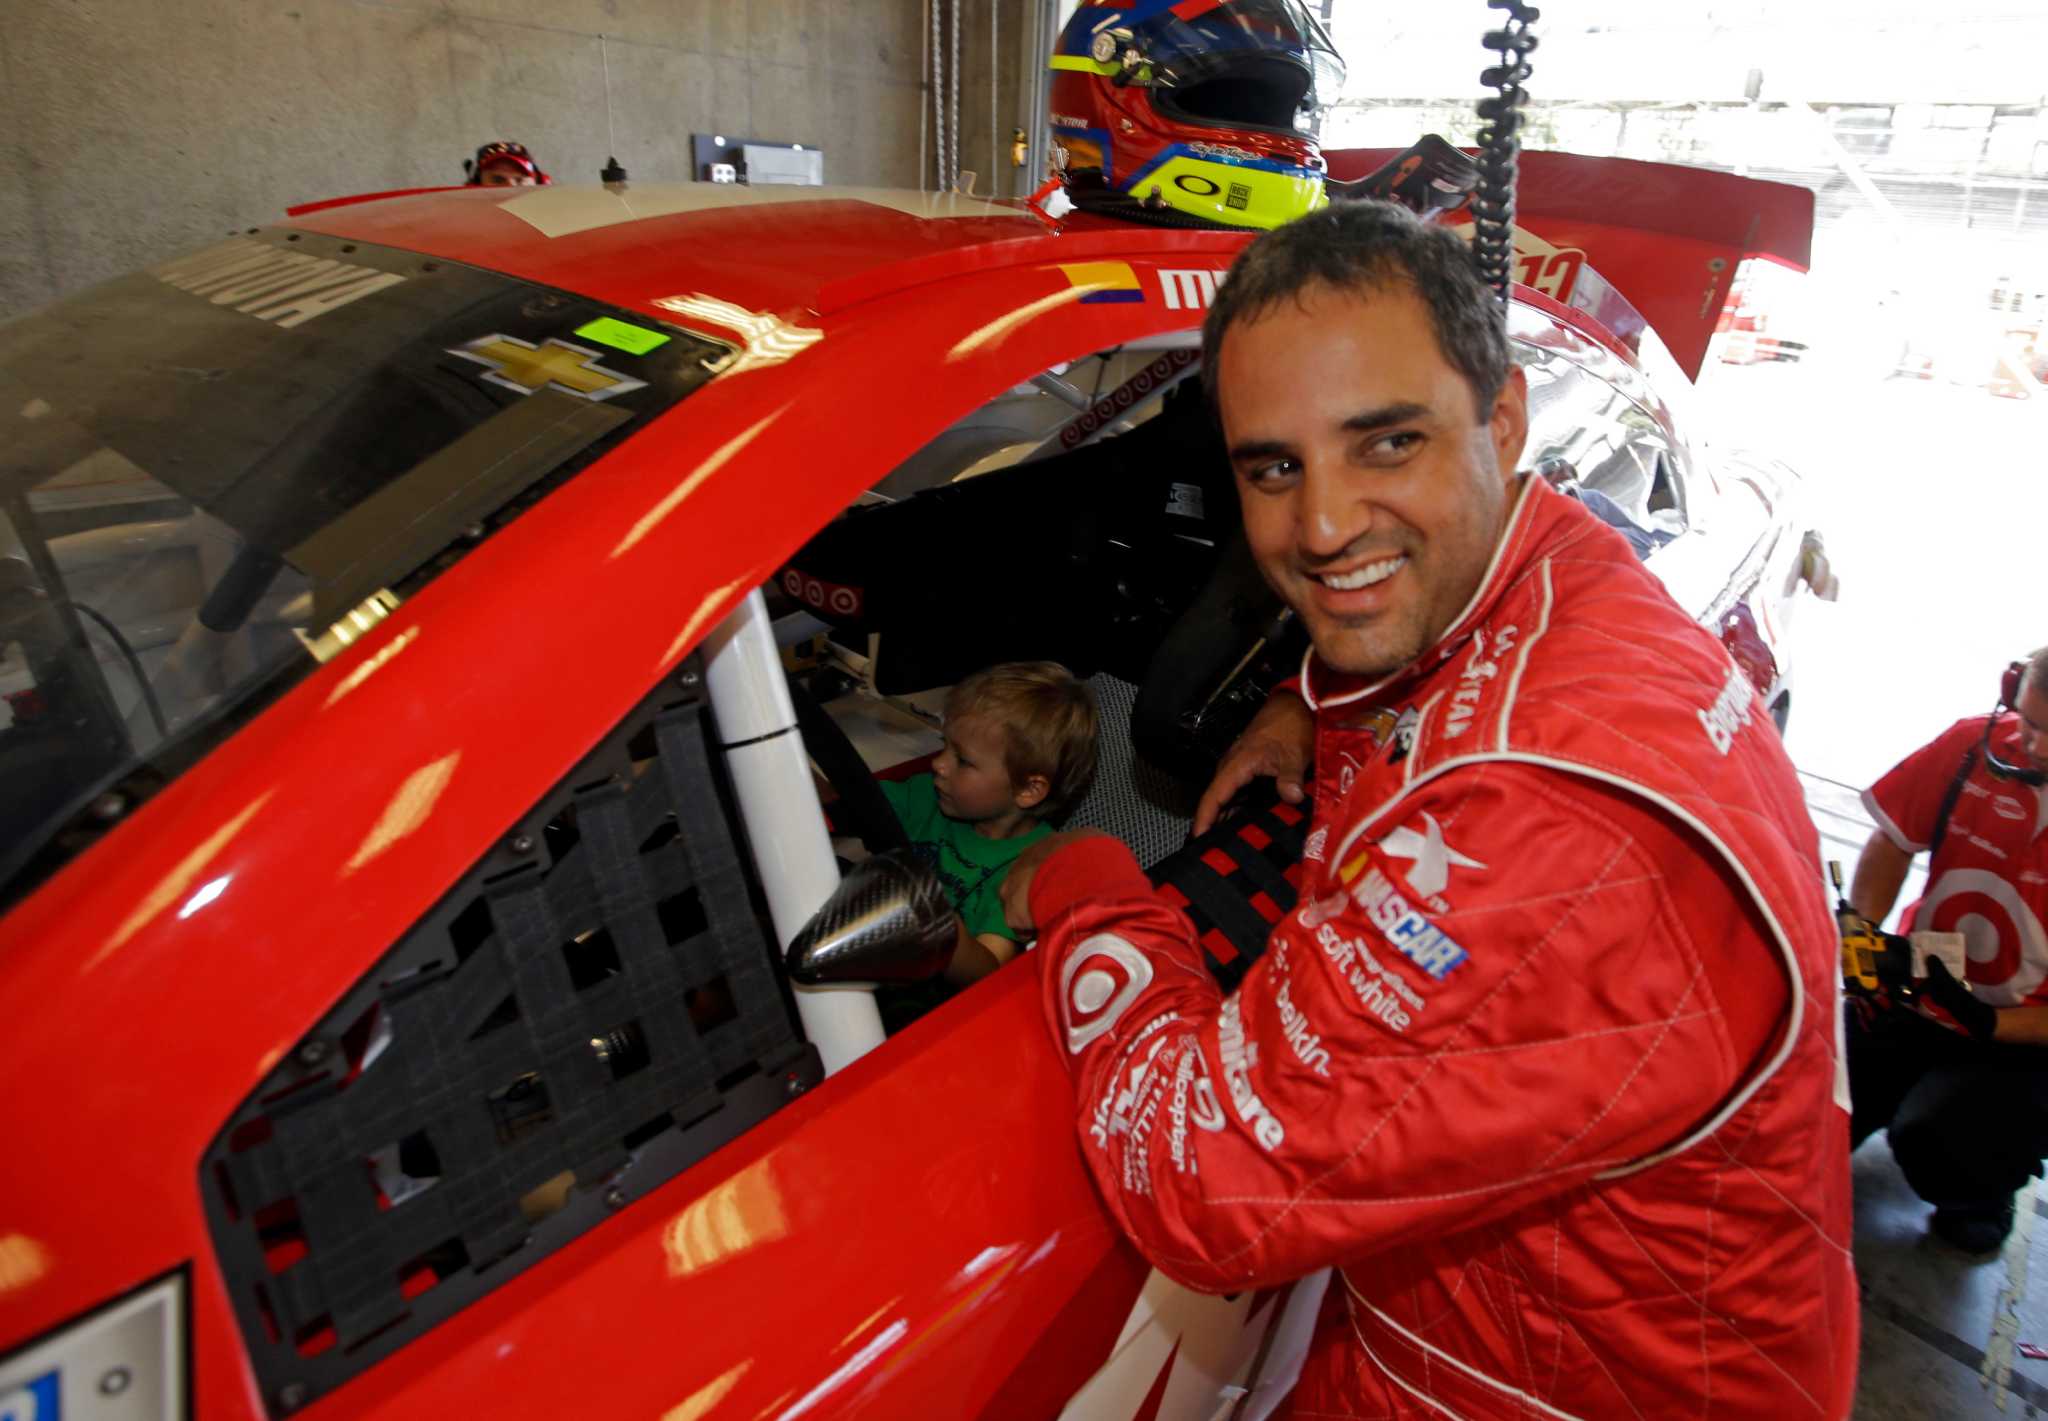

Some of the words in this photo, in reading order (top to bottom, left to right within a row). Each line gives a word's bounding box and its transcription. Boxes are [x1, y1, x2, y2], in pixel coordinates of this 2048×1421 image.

[1316, 923, 1356, 974] soft
[1350, 966, 1411, 1032] white
[1351, 867, 1470, 981] NASCAR
[1275, 979, 1330, 1077] belkin
